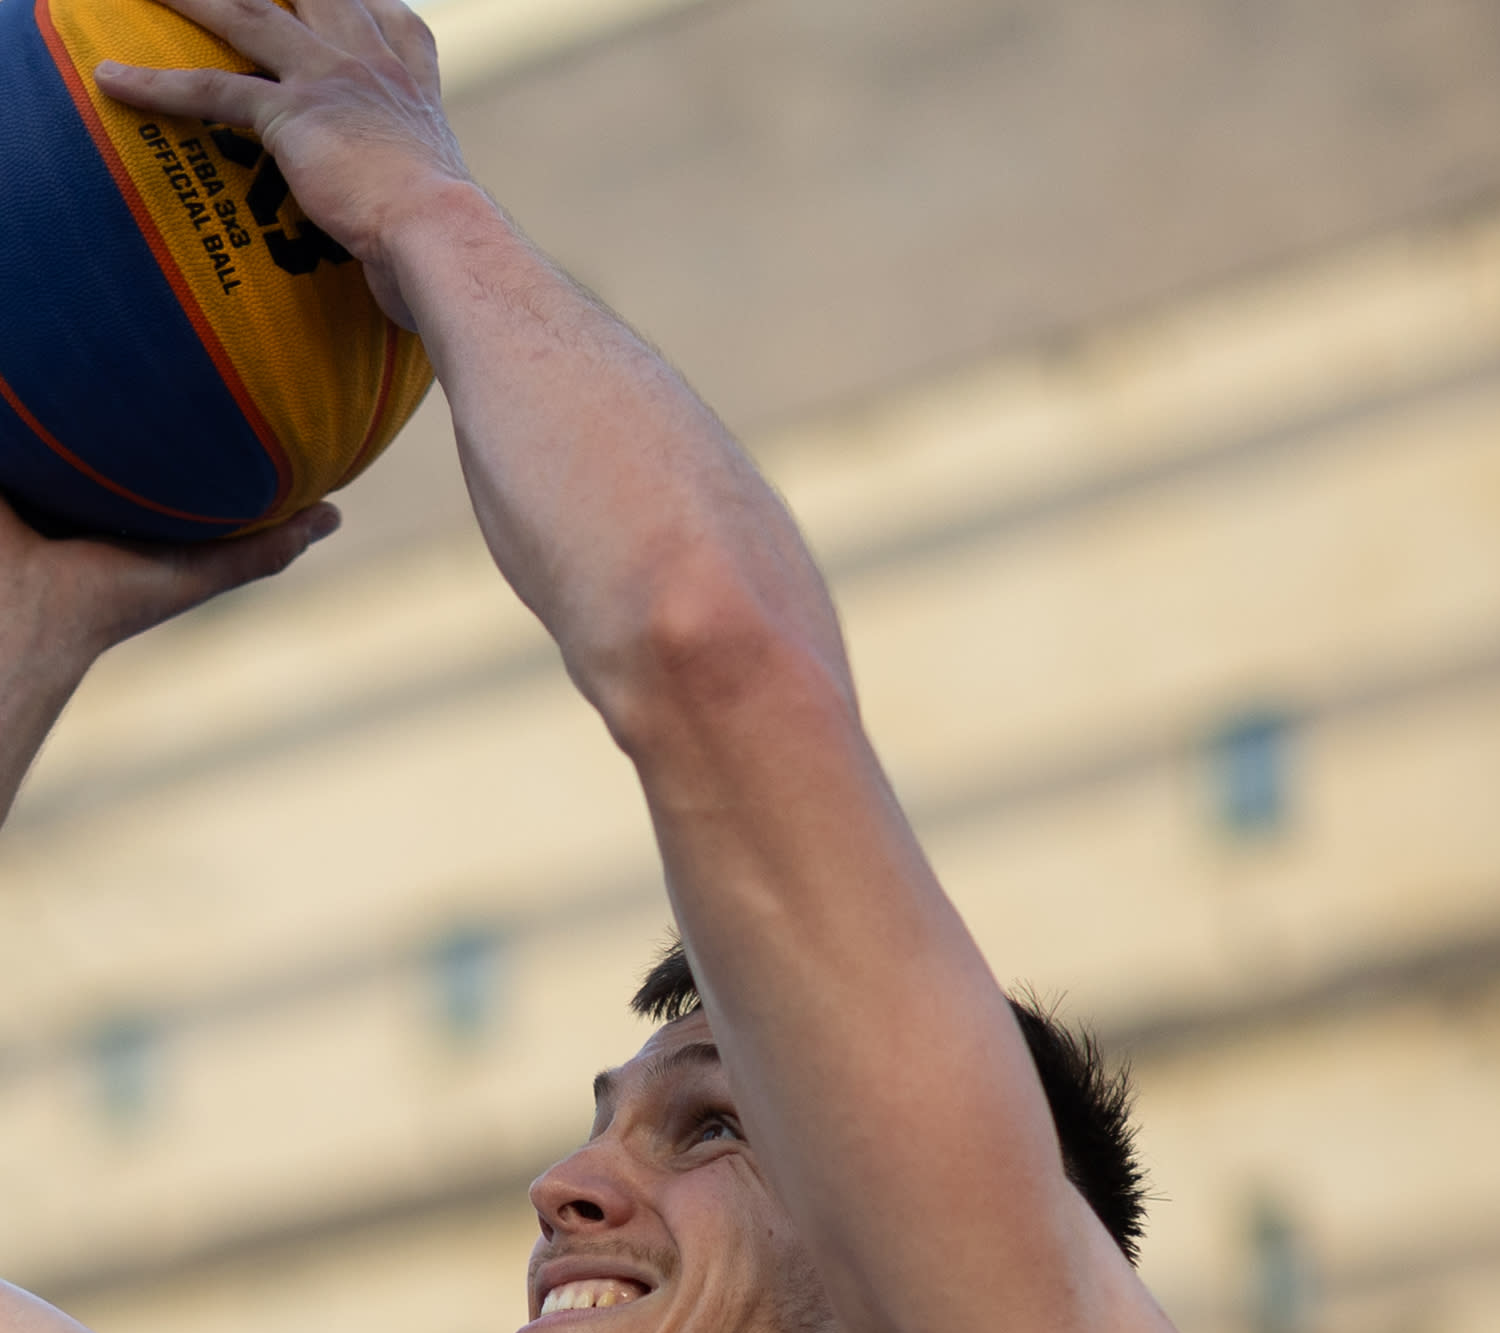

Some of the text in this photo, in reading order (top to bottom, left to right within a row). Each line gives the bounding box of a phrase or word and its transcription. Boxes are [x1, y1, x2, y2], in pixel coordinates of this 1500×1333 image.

[138, 123, 242, 296] OFFICIAL BALL
[179, 138, 252, 249] FIBA 3x3
